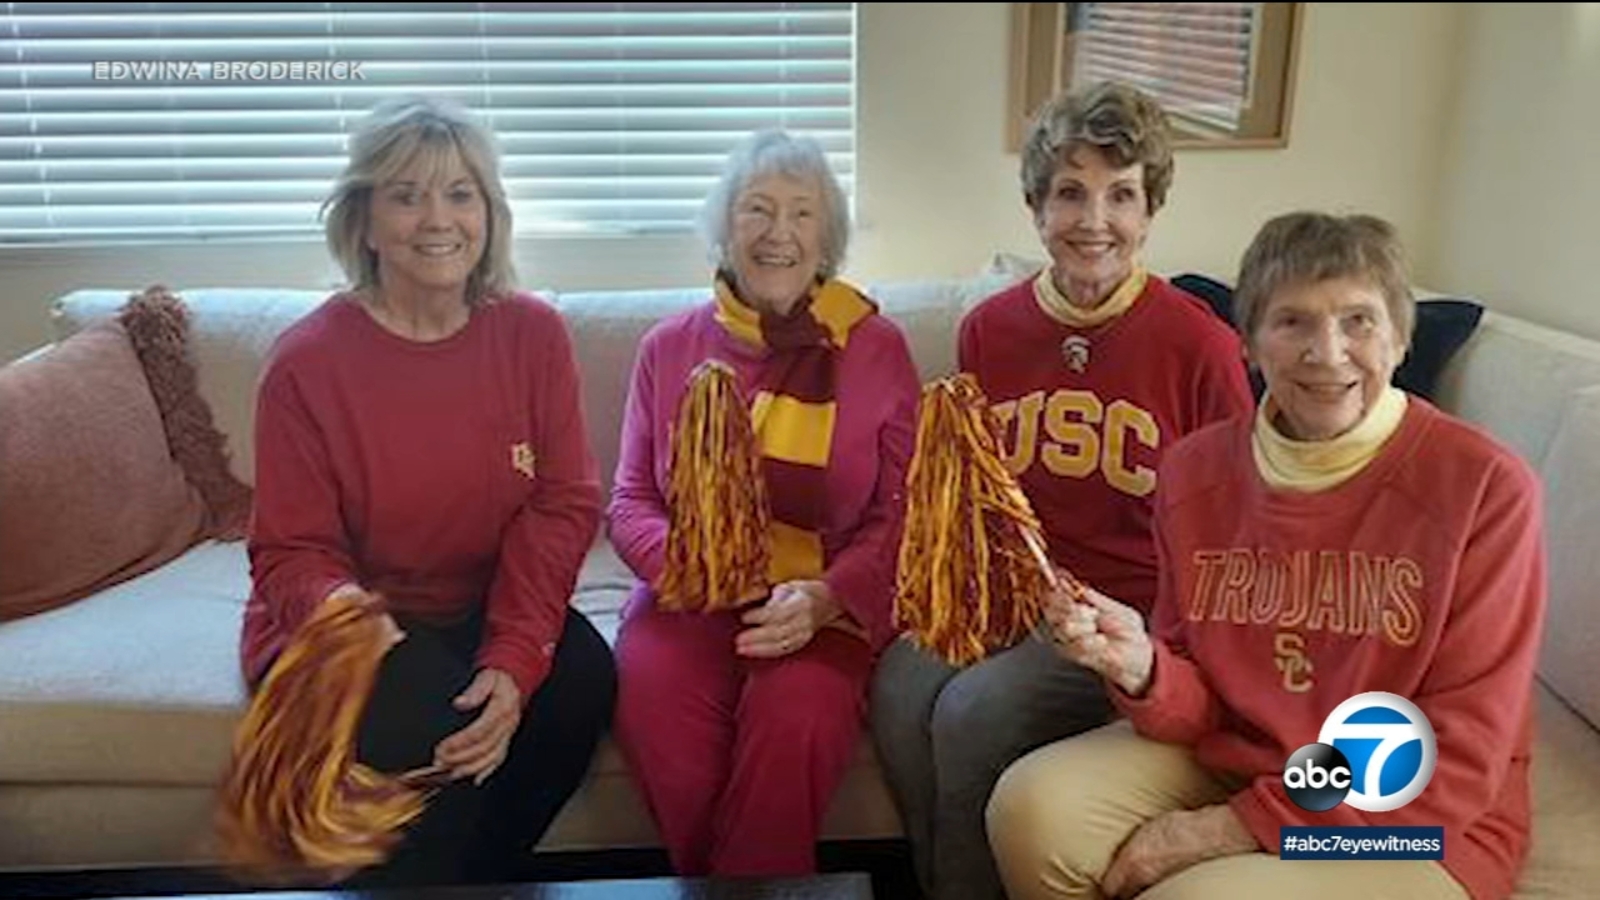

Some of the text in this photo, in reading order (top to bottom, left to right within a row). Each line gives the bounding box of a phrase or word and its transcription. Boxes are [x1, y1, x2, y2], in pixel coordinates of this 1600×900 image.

[990, 389, 1160, 497] USC
[1189, 548, 1424, 646] TROJANS
[1274, 633, 1314, 692] SC
